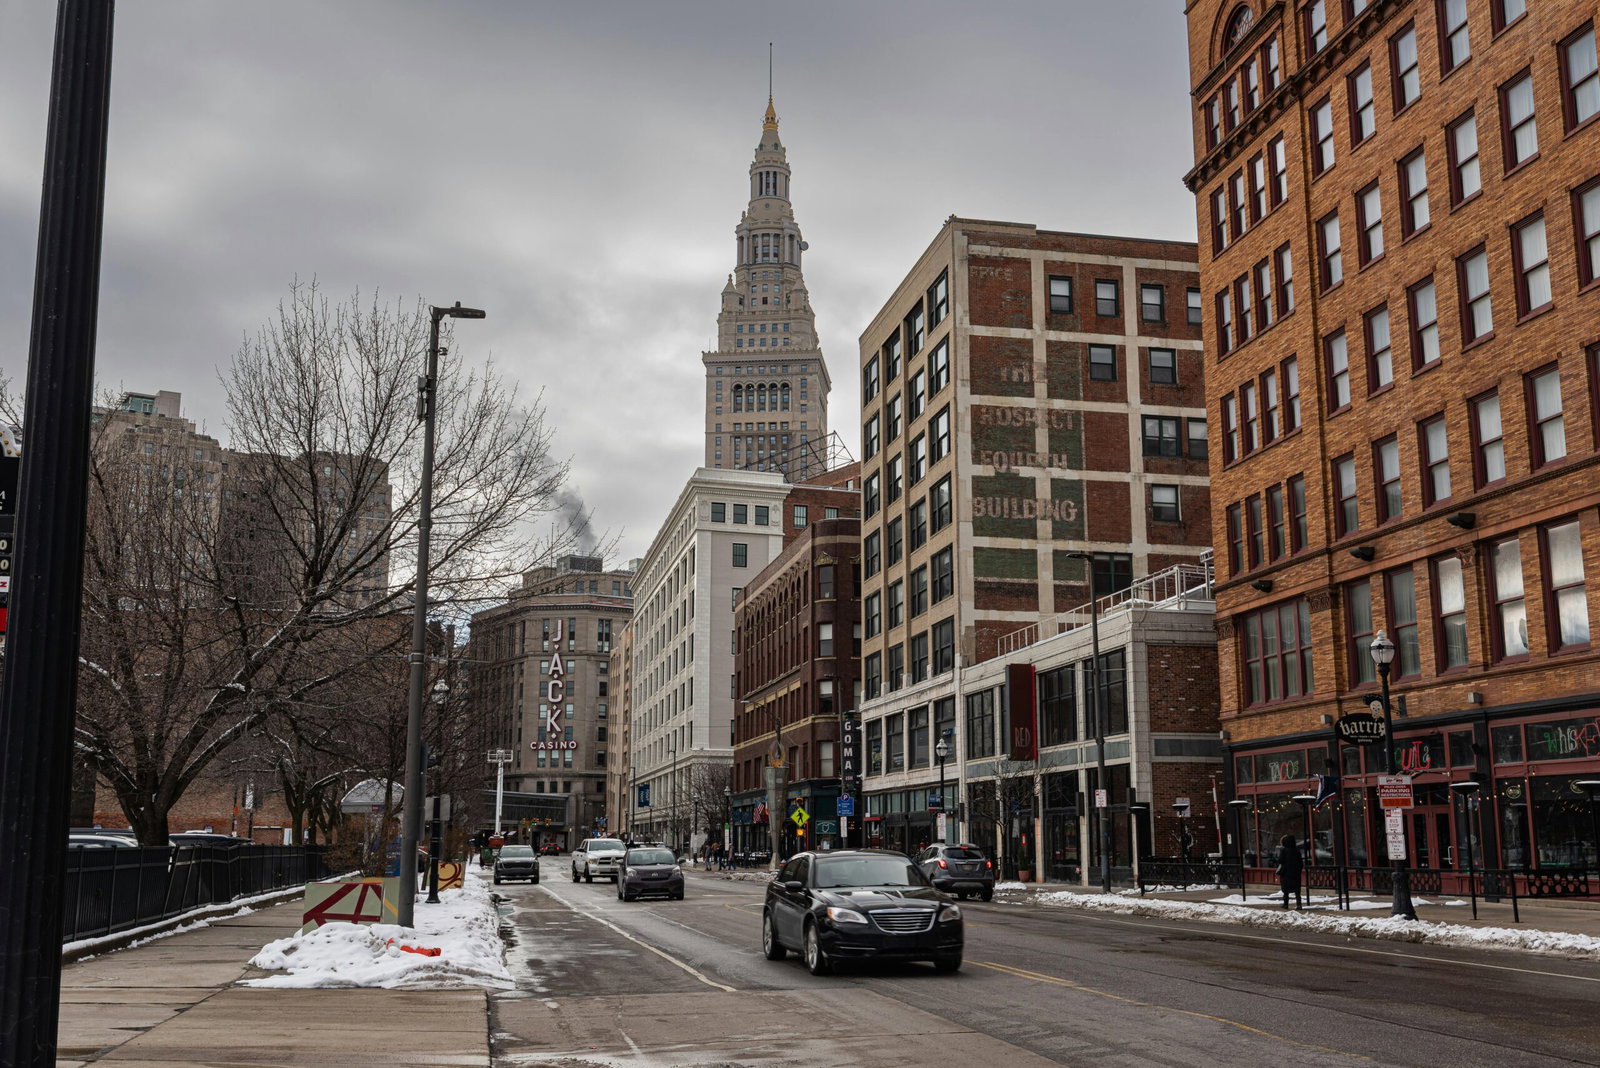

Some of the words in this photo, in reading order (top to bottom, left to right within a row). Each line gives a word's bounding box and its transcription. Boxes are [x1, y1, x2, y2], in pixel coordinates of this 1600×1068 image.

[972, 497, 1078, 522] BUILDING
[546, 619, 564, 733] JACK
[530, 740, 577, 750] CASINO
[843, 721, 853, 770] GOMA
[1014, 727, 1031, 747] RED
